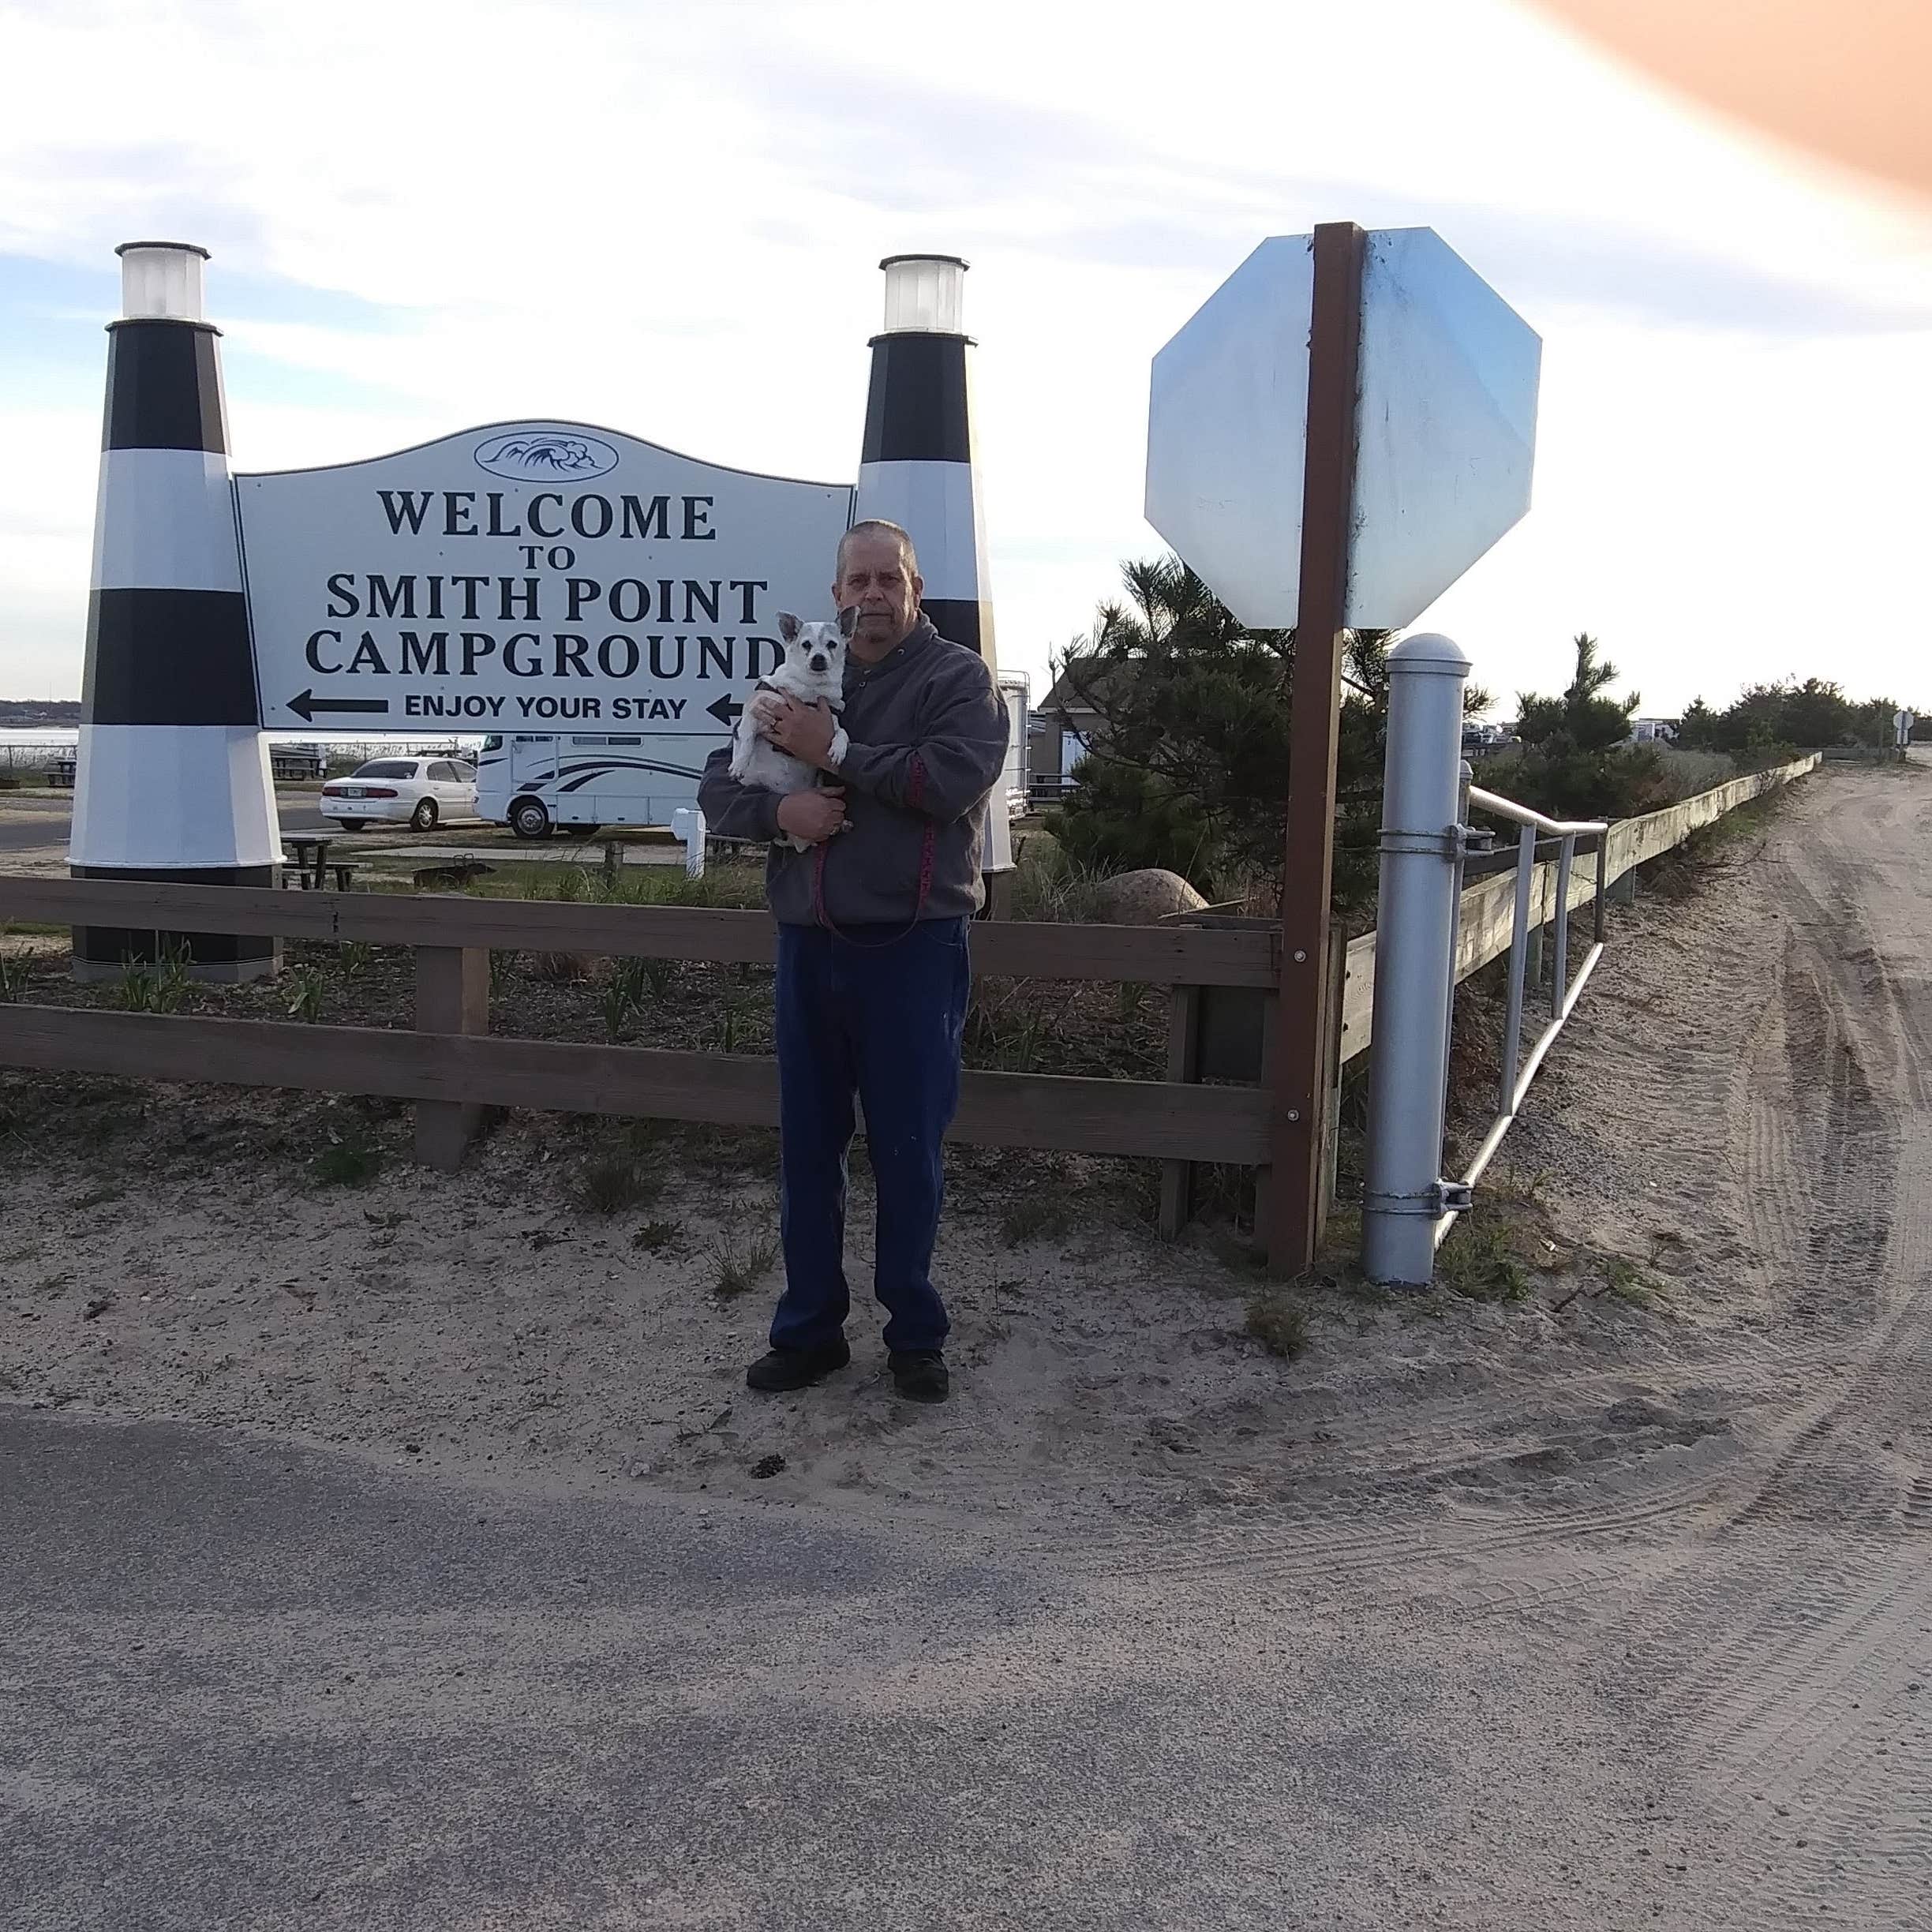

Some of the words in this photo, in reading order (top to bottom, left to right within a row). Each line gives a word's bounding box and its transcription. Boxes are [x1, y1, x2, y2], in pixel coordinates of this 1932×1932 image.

[376, 490, 717, 541] WELCOME
[518, 545, 576, 571] TO
[327, 573, 541, 622] SMITH
[564, 577, 769, 625] POINT
[305, 629, 787, 680] CAMPGROUND
[405, 695, 507, 718] ENJOY
[515, 696, 601, 719] YOUR
[612, 697, 688, 720] STAY
